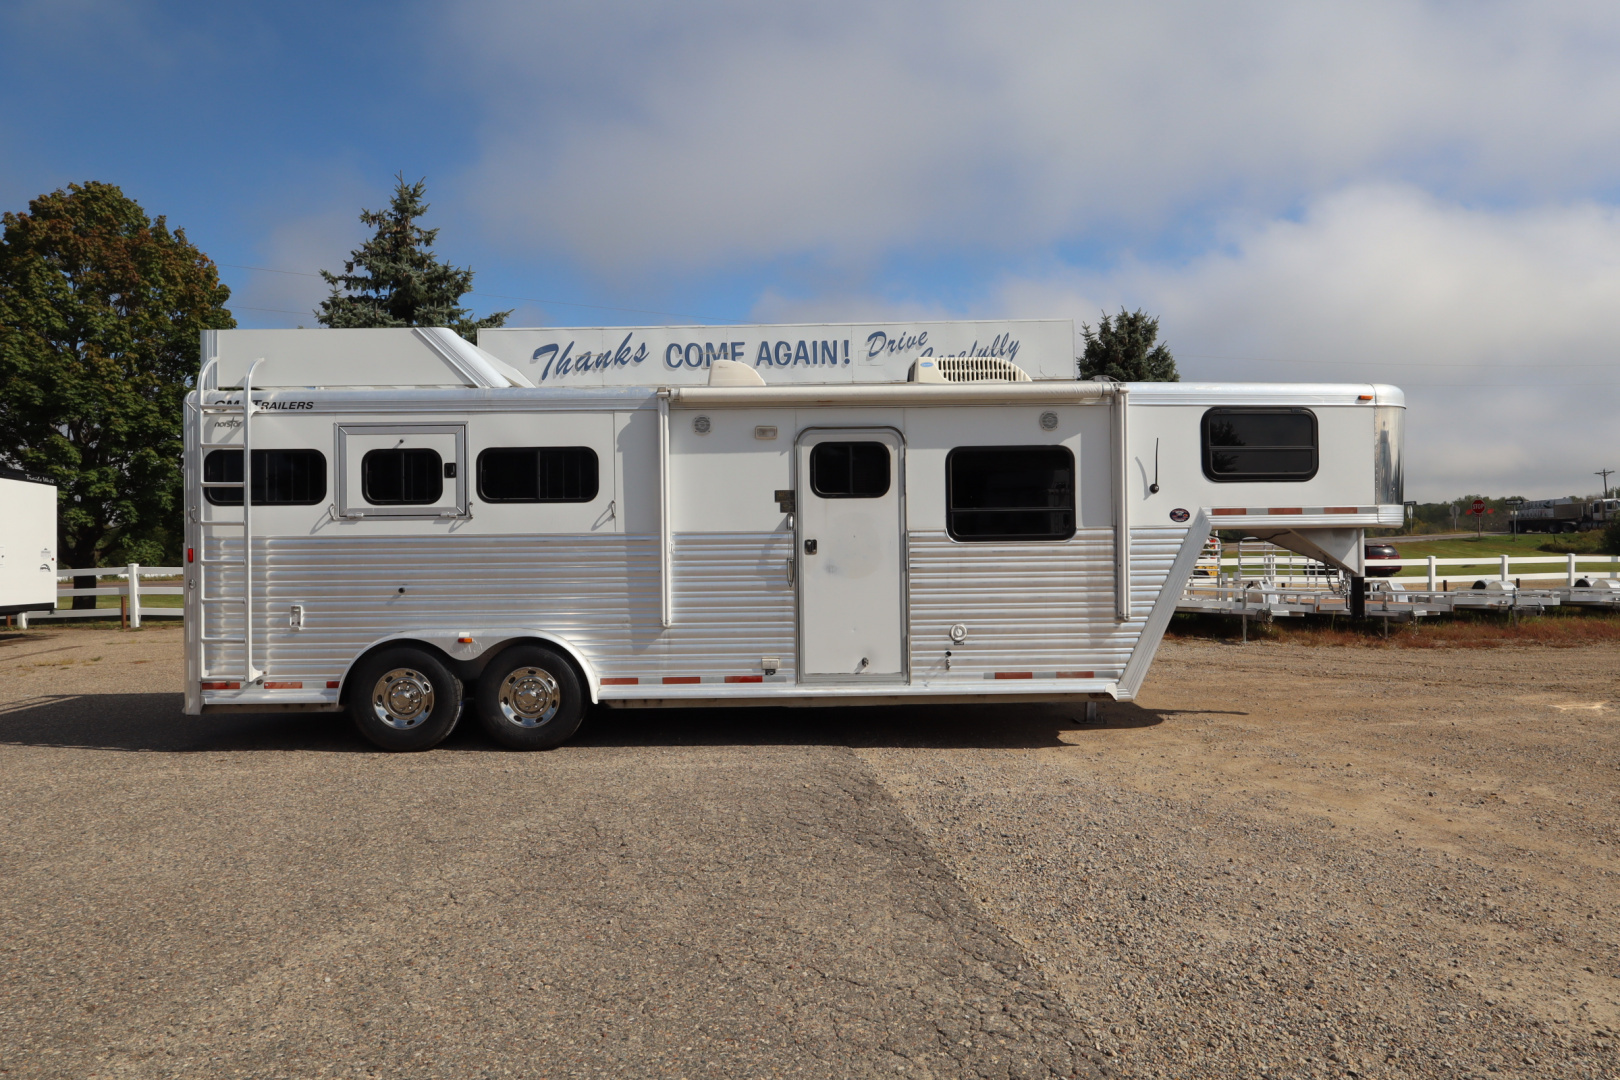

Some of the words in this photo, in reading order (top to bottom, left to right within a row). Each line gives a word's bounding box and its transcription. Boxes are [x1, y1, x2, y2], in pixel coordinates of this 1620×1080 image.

[532, 332, 649, 380] Thanks
[666, 341, 745, 368] COME
[756, 339, 850, 366] AGAIN!
[867, 331, 928, 358] Drive
